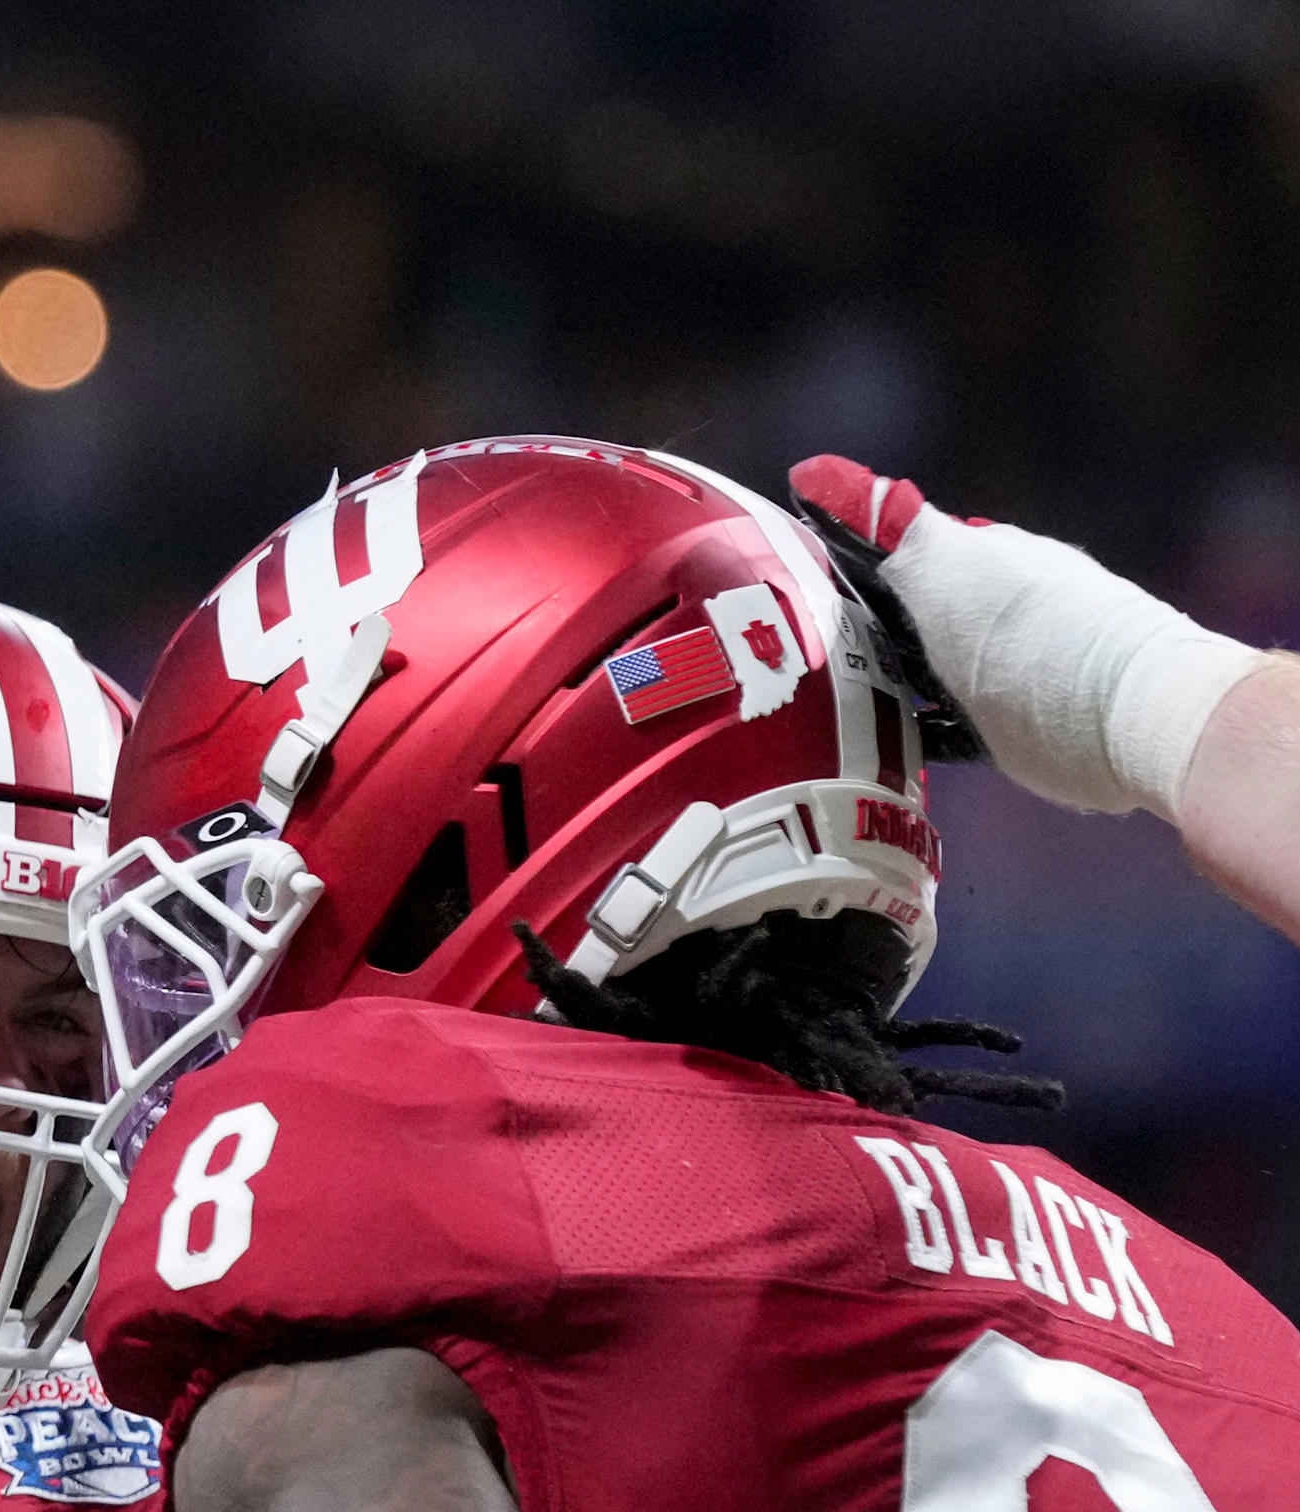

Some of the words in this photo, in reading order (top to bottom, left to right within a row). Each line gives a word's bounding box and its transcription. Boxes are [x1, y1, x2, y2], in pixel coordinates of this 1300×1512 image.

[155, 1101, 280, 1291] 8
[853, 1135, 1174, 1347] BLACK
[38, 1446, 161, 1477] BOWL
